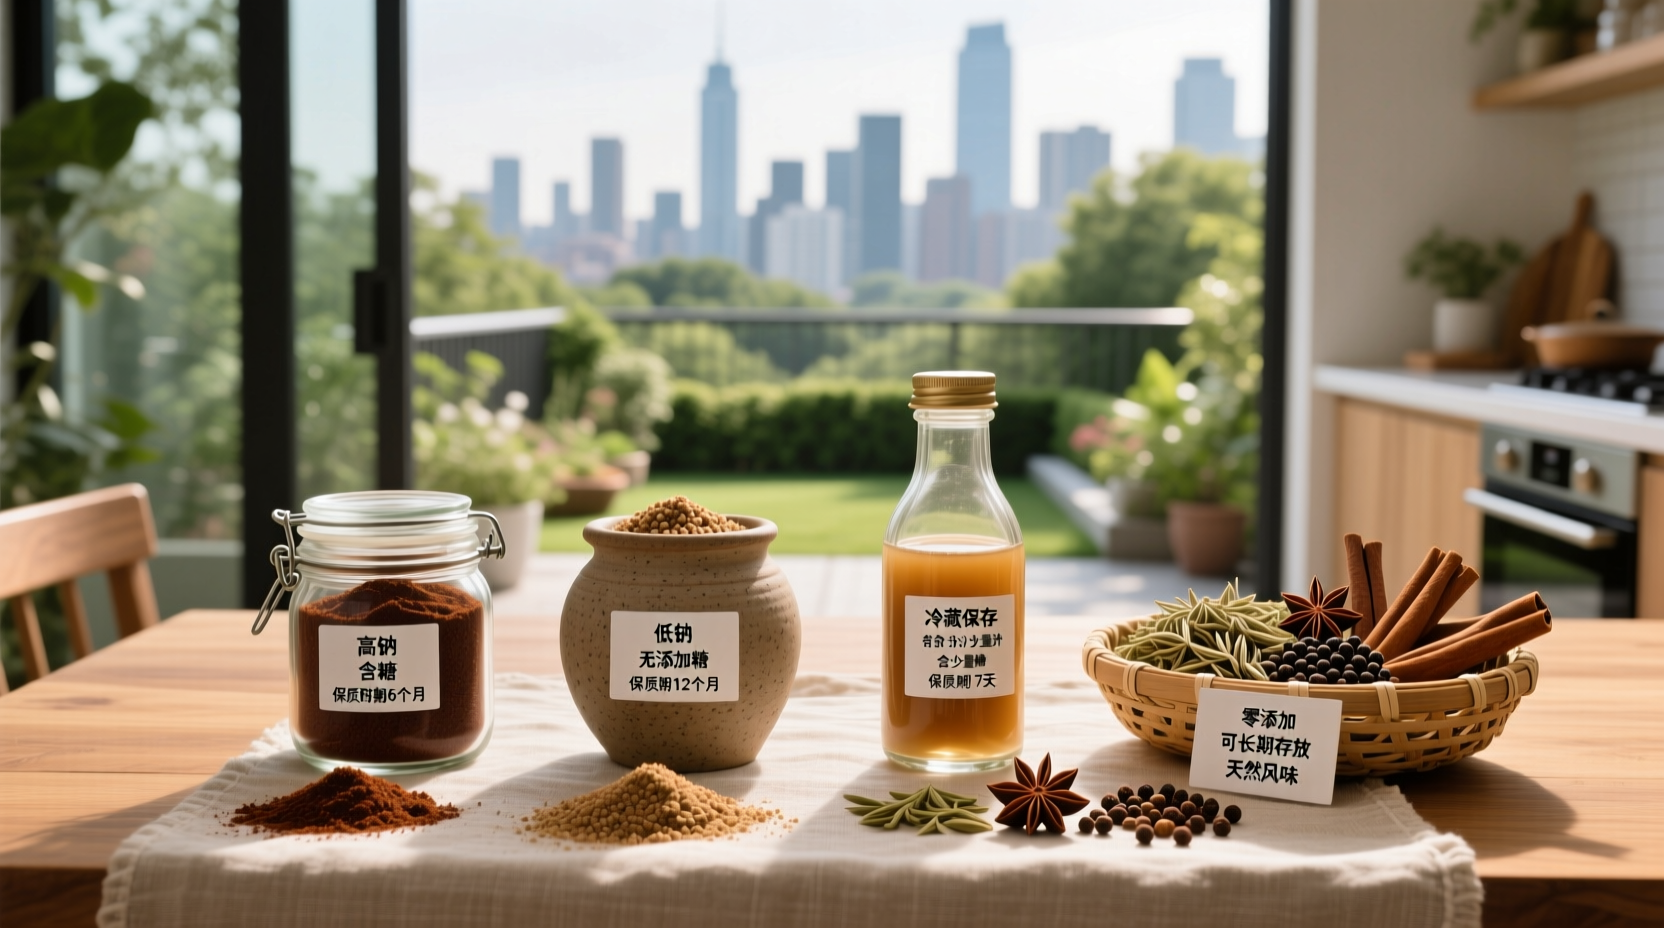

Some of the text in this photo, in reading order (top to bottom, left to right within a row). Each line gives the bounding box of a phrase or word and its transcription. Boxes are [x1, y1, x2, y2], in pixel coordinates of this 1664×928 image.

[925, 607, 998, 628] 冷藏保存
[357, 635, 397, 657] 高钠
[639, 650, 708, 669] 无添加糖
[359, 661, 397, 681] 含糖
[1242, 708, 1296, 730] 零添加
[1222, 732, 1311, 759] 可长期存放
[1226, 759, 1299, 785] 天然风味
